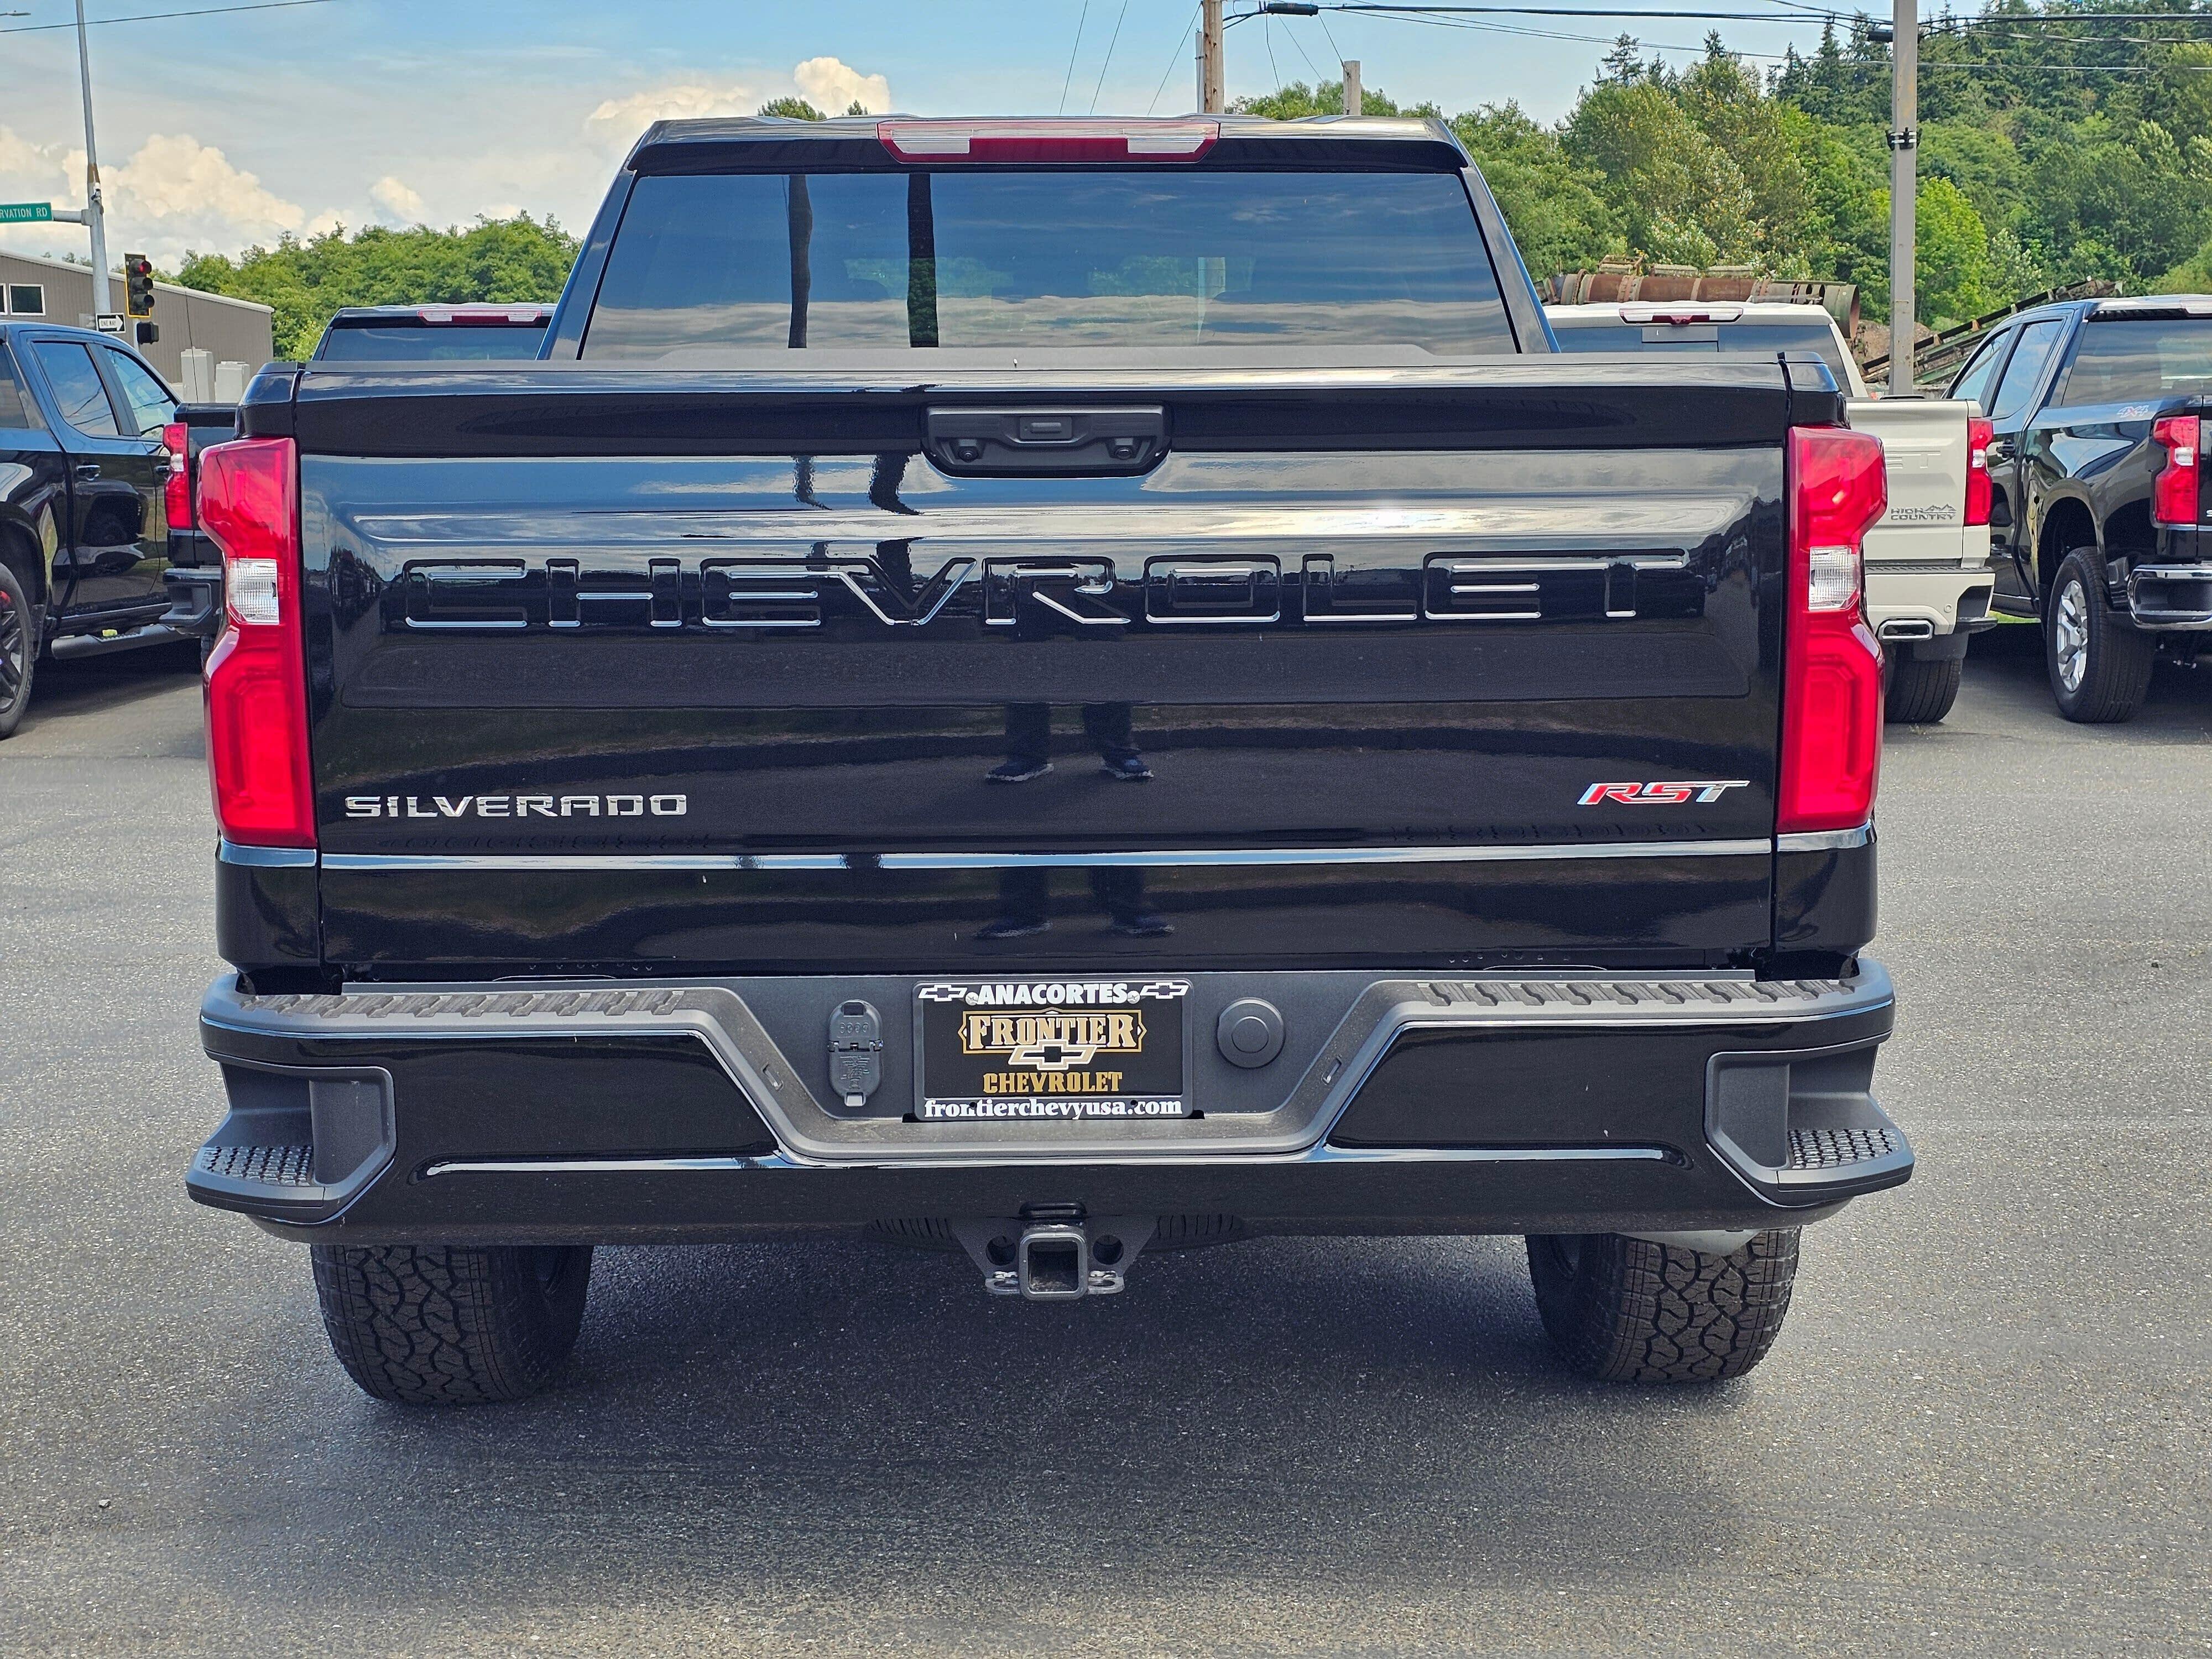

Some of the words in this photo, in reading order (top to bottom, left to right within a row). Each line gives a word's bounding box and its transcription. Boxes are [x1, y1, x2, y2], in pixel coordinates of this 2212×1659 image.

[36, 207, 48, 217] RD
[403, 552, 1689, 629] CHEVROLET
[1577, 780, 1751, 805] RST
[345, 794, 687, 817] SILVERADO
[978, 984, 1128, 1005] ANACORTES
[968, 1014, 1137, 1049] FRONTIER
[983, 1072, 1123, 1093] CHEVROLET
[924, 1098, 1183, 1120] frontierchevyusa.com
